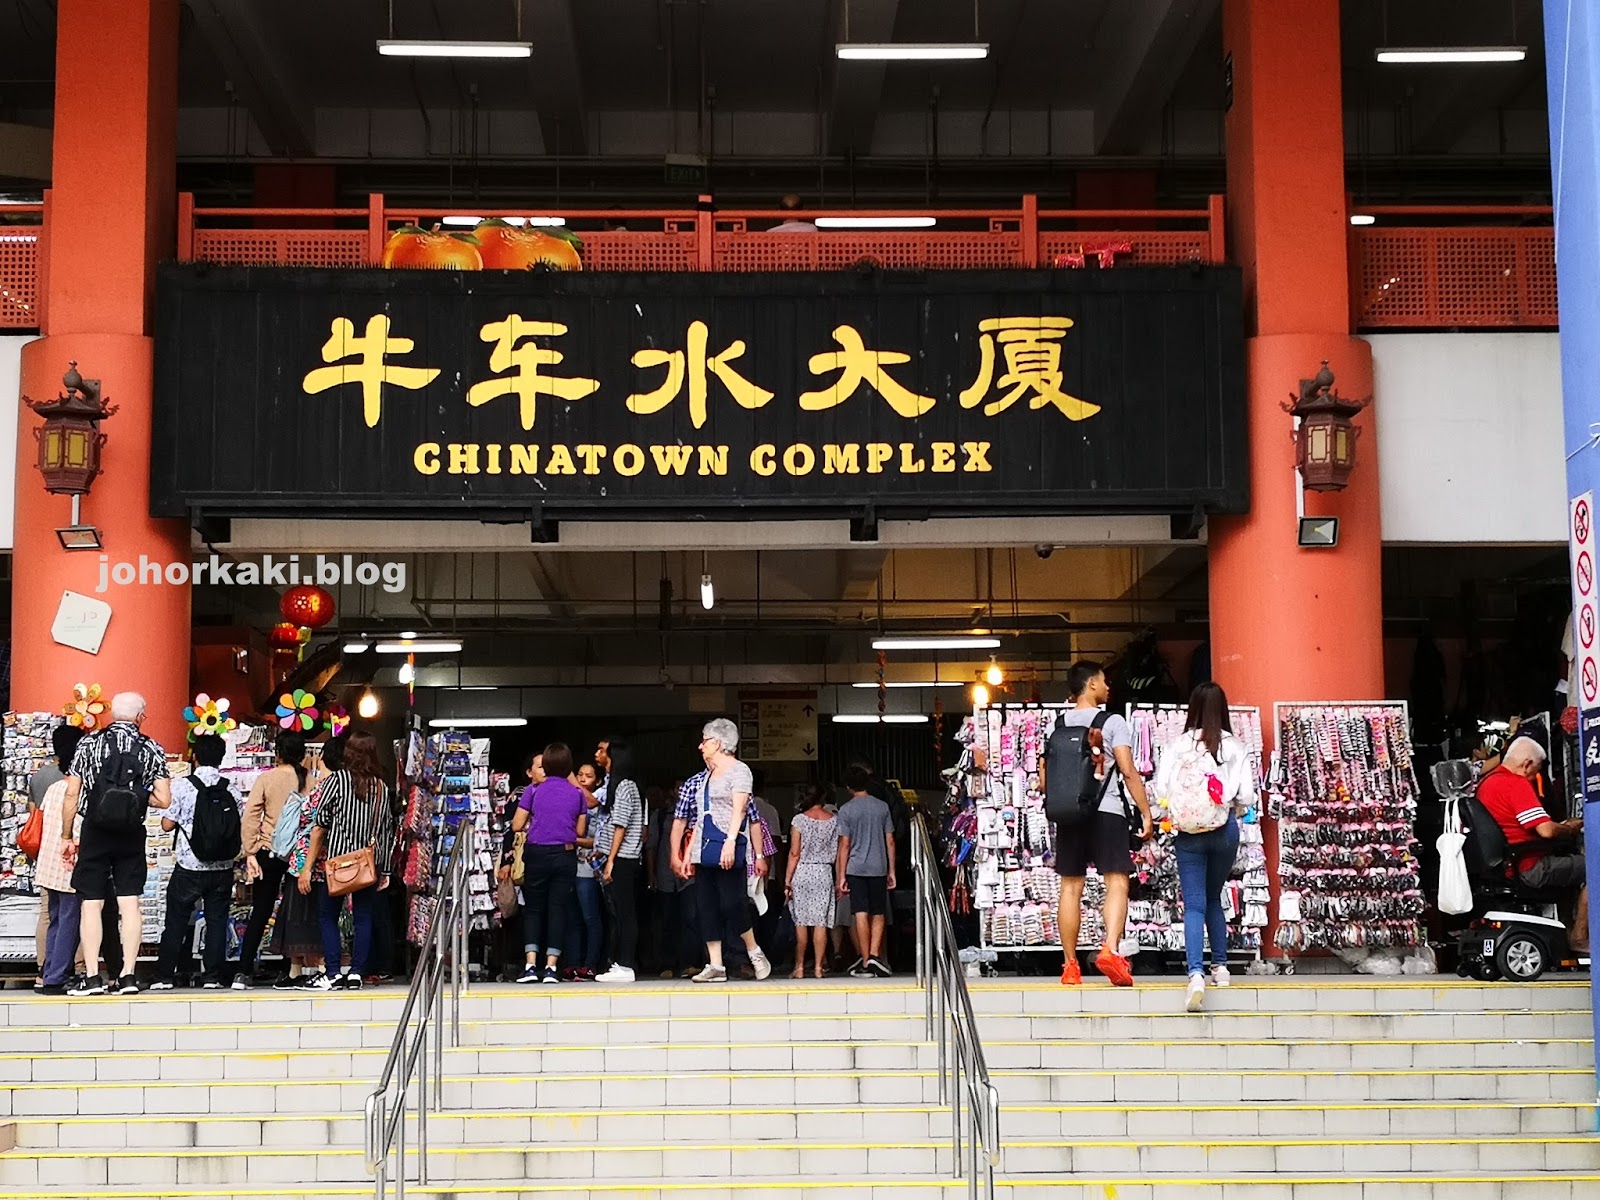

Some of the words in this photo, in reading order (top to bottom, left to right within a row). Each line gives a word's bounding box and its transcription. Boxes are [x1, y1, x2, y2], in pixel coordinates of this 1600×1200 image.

[302, 313, 1102, 429] 牛车水大厦
[413, 442, 729, 477] CHINATOWN
[750, 441, 993, 476] COMPLEX
